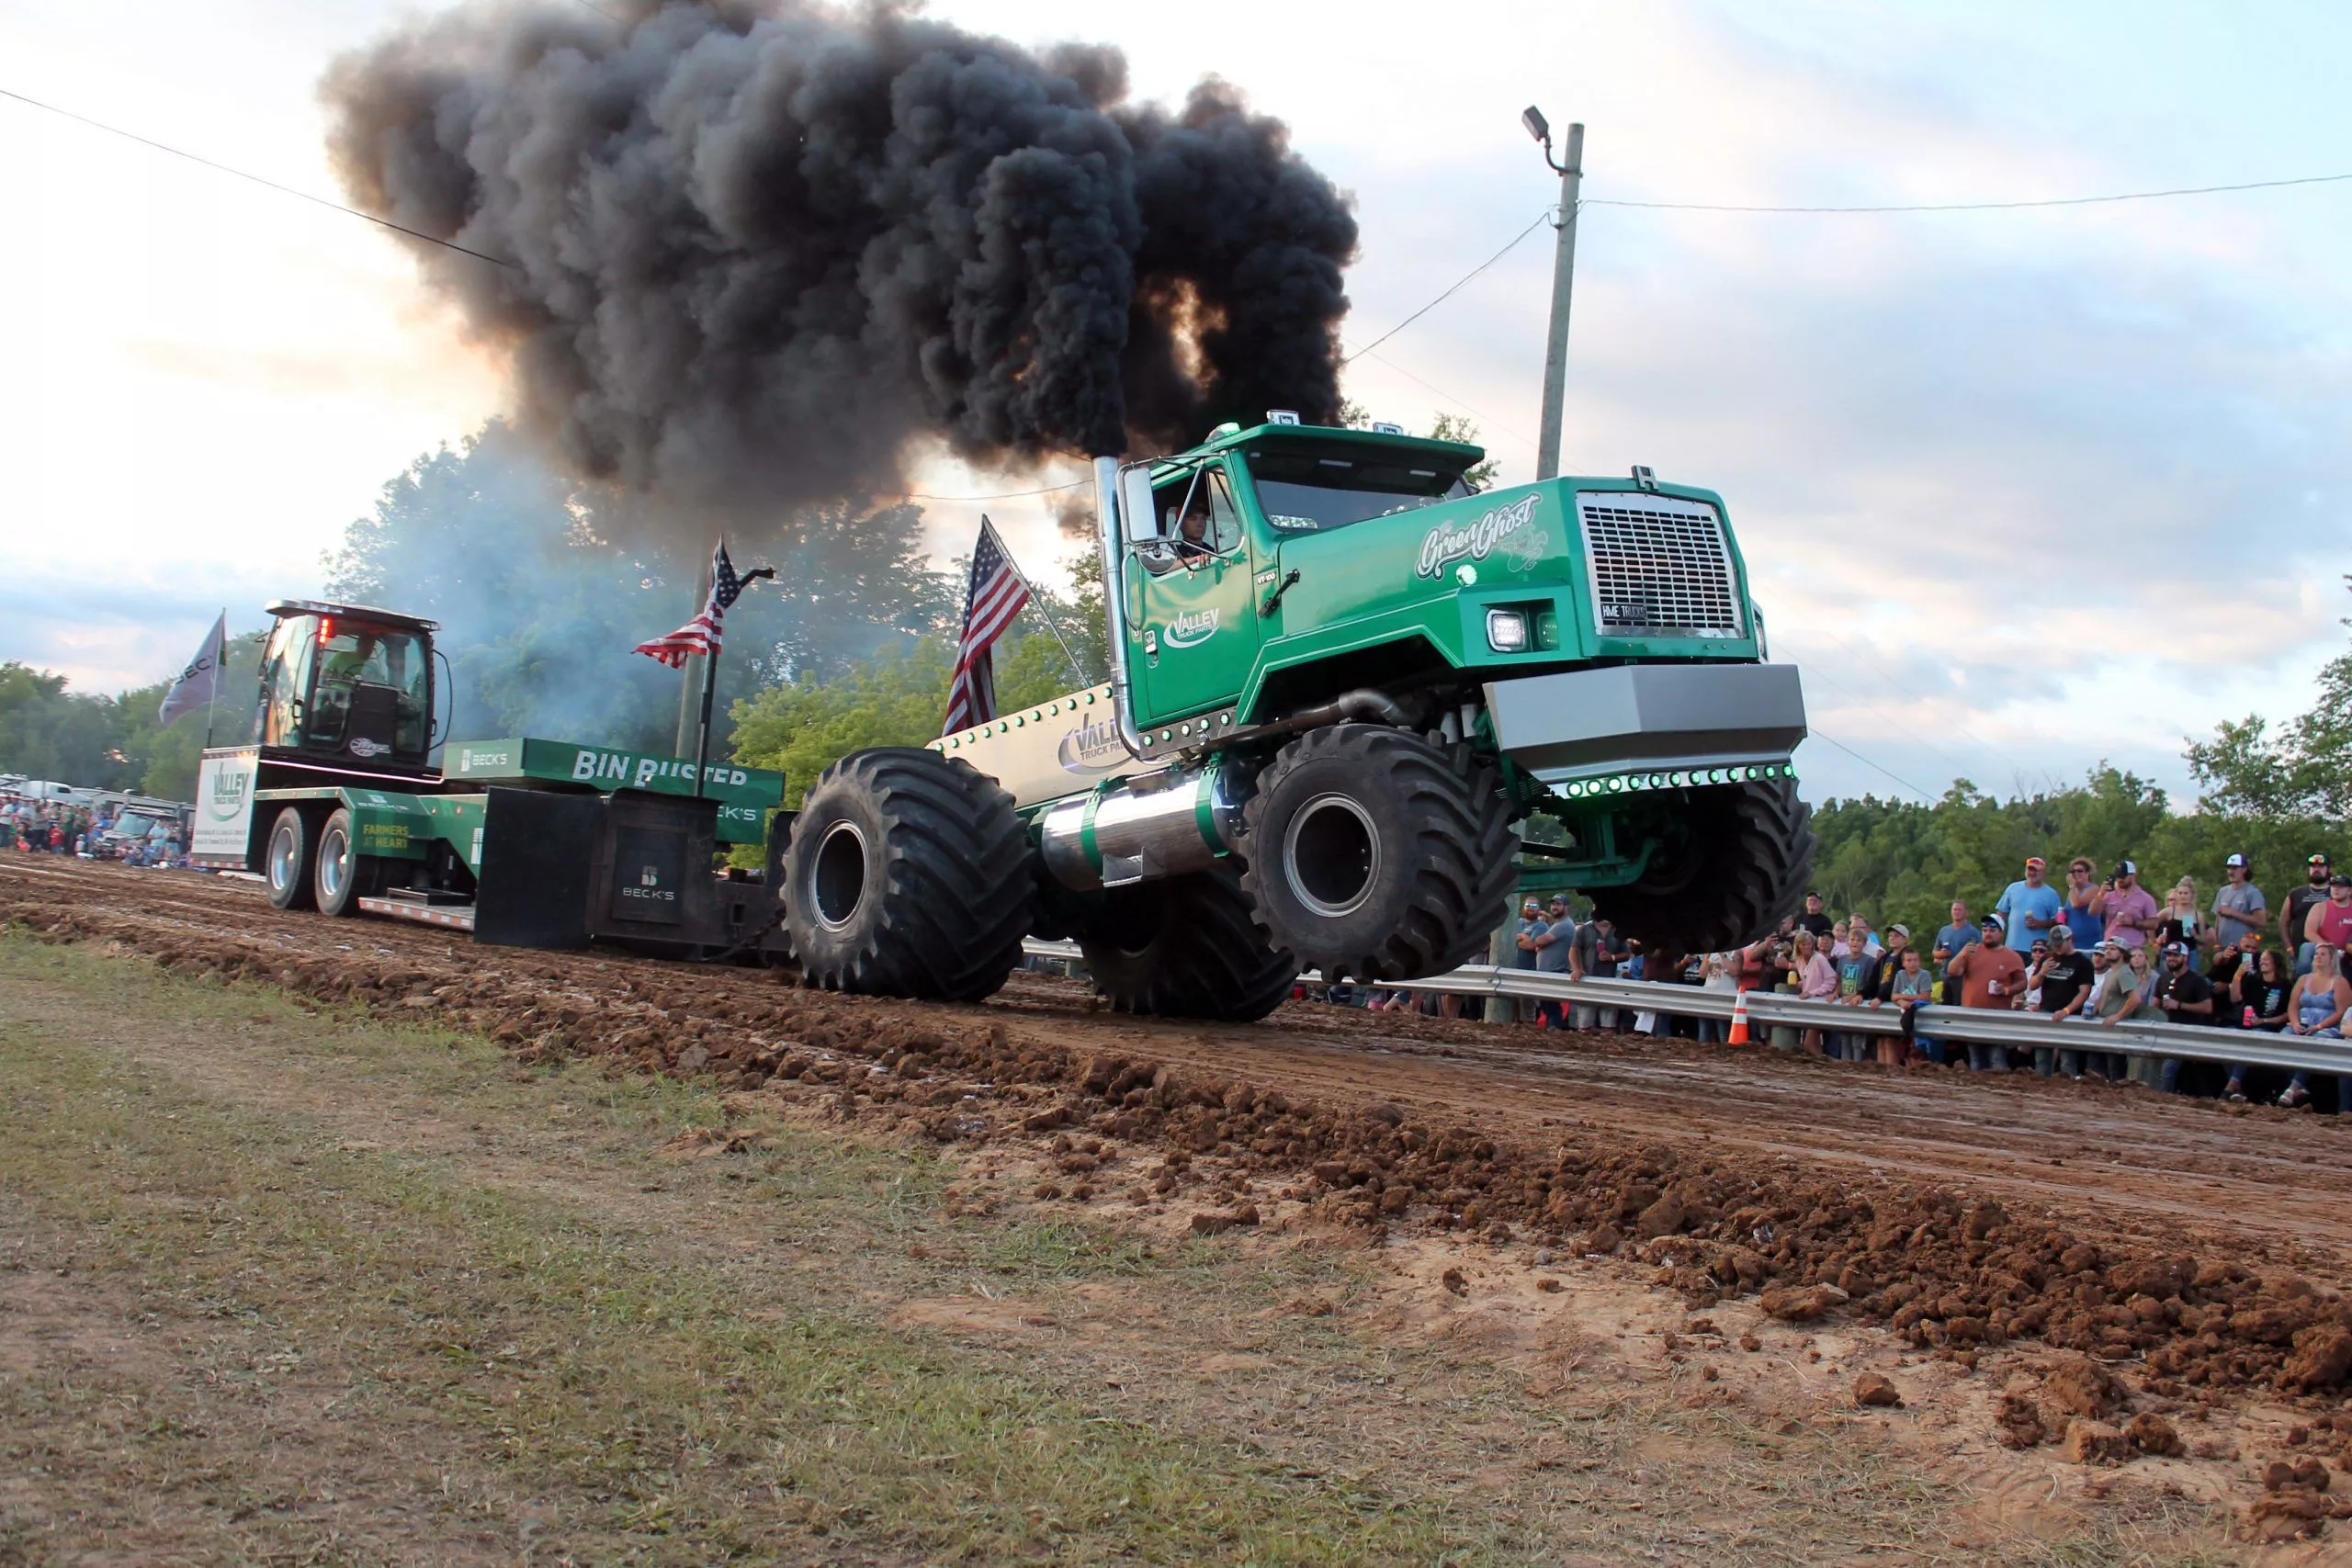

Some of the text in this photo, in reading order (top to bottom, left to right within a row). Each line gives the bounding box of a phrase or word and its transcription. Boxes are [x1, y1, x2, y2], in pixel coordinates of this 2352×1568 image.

[1416, 492, 1541, 579] Green Ghost
[1602, 604, 1620, 618] HME
[1173, 607, 1220, 635] VALLEY
[1176, 624, 1212, 640] TRUCK PARTS
[1073, 713, 1121, 751] VALL
[472, 753, 508, 766] BECK'S
[1080, 745, 1109, 761] TRUCK
[571, 750, 630, 781] BIN
[213, 761, 250, 797] VALLEY
[363, 824, 409, 836] FARMERS
[376, 837, 407, 848] HEART
[623, 886, 675, 901] BECK'S
